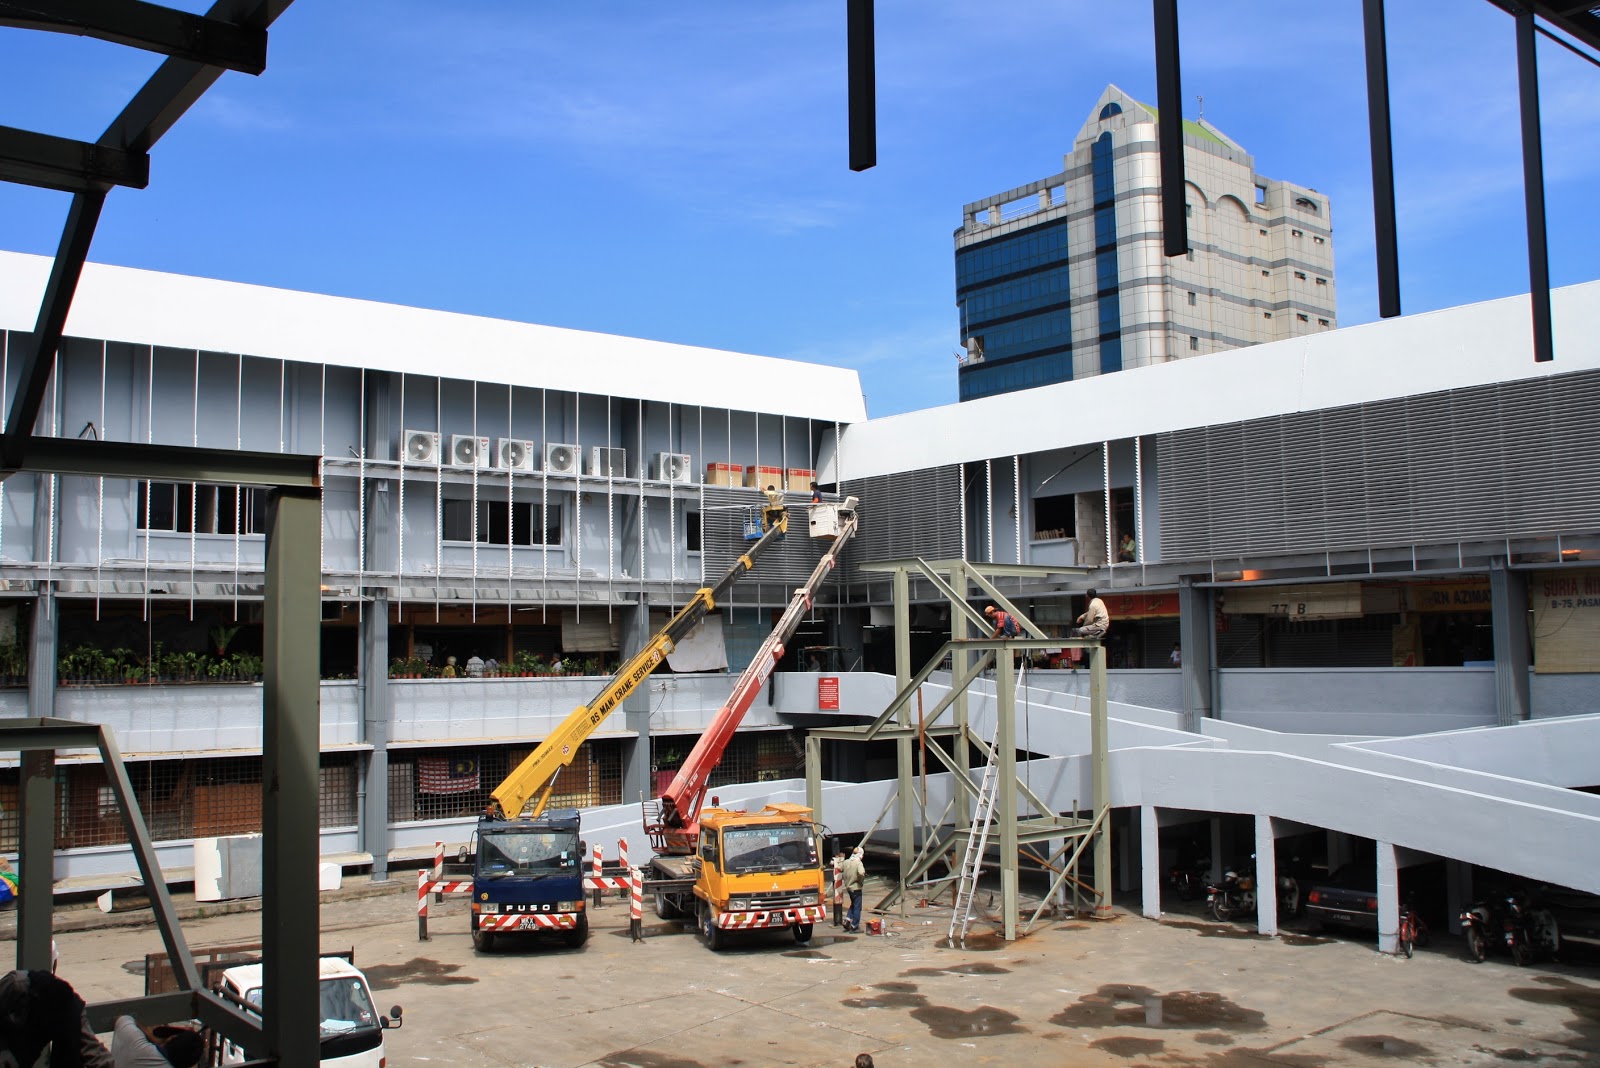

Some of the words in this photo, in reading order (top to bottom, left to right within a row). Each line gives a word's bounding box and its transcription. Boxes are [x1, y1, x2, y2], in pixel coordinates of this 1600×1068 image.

[590, 712, 601, 725] RS
[599, 697, 616, 716] MANI
[614, 678, 634, 701] CRANE
[632, 656, 655, 682] SERVICE
[751, 890, 800, 898] FUSO
[506, 904, 550, 912] FUSO
